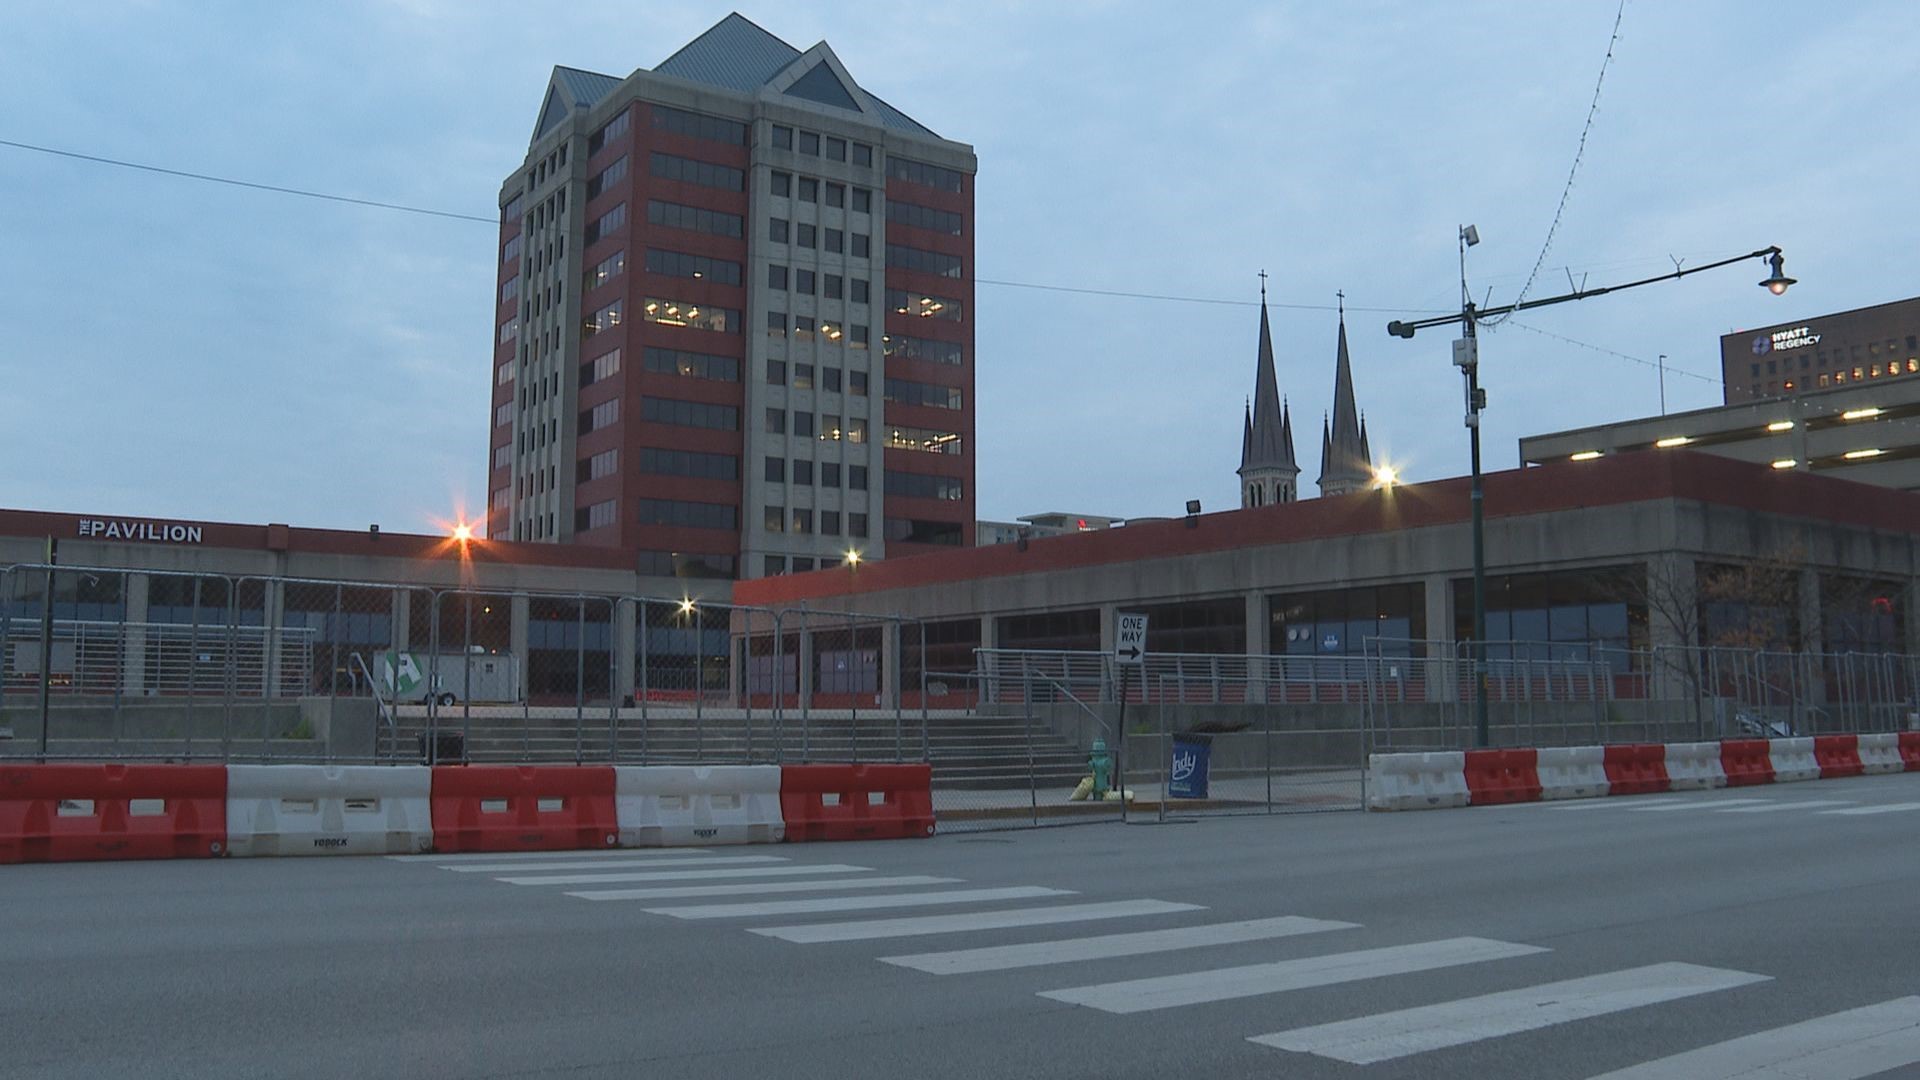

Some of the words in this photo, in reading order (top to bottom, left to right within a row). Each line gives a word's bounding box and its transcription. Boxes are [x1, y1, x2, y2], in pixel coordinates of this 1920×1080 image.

[1772, 327, 1809, 342] HYATT
[1773, 335, 1821, 351] REGENCY
[79, 520, 91, 536] THE
[91, 521, 202, 542] PAVILION
[1122, 616, 1143, 630] ONE
[1121, 631, 1143, 643] WAY
